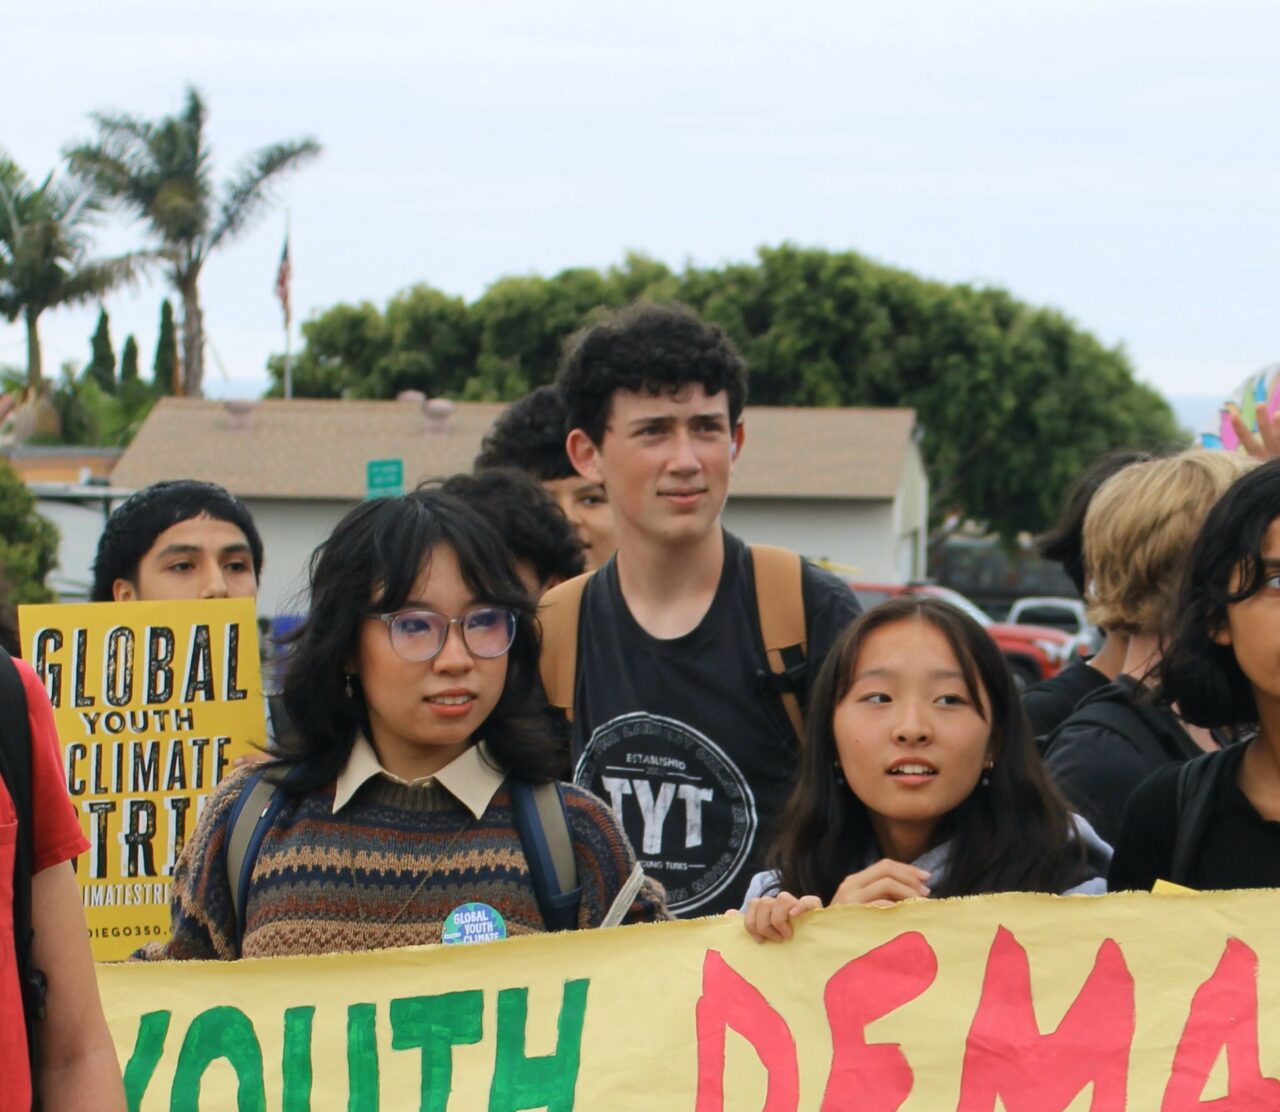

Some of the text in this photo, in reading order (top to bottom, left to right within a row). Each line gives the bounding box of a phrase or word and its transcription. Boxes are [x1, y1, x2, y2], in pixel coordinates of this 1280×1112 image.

[33, 622, 248, 709] GLOBAL
[81, 708, 194, 735] YOUTH
[65, 736, 232, 797] CLIMATE
[74, 795, 208, 880] TRI
[600, 775, 714, 855] TYT
[453, 910, 489, 925] GLOBAL
[464, 921, 493, 935] YOUTH
